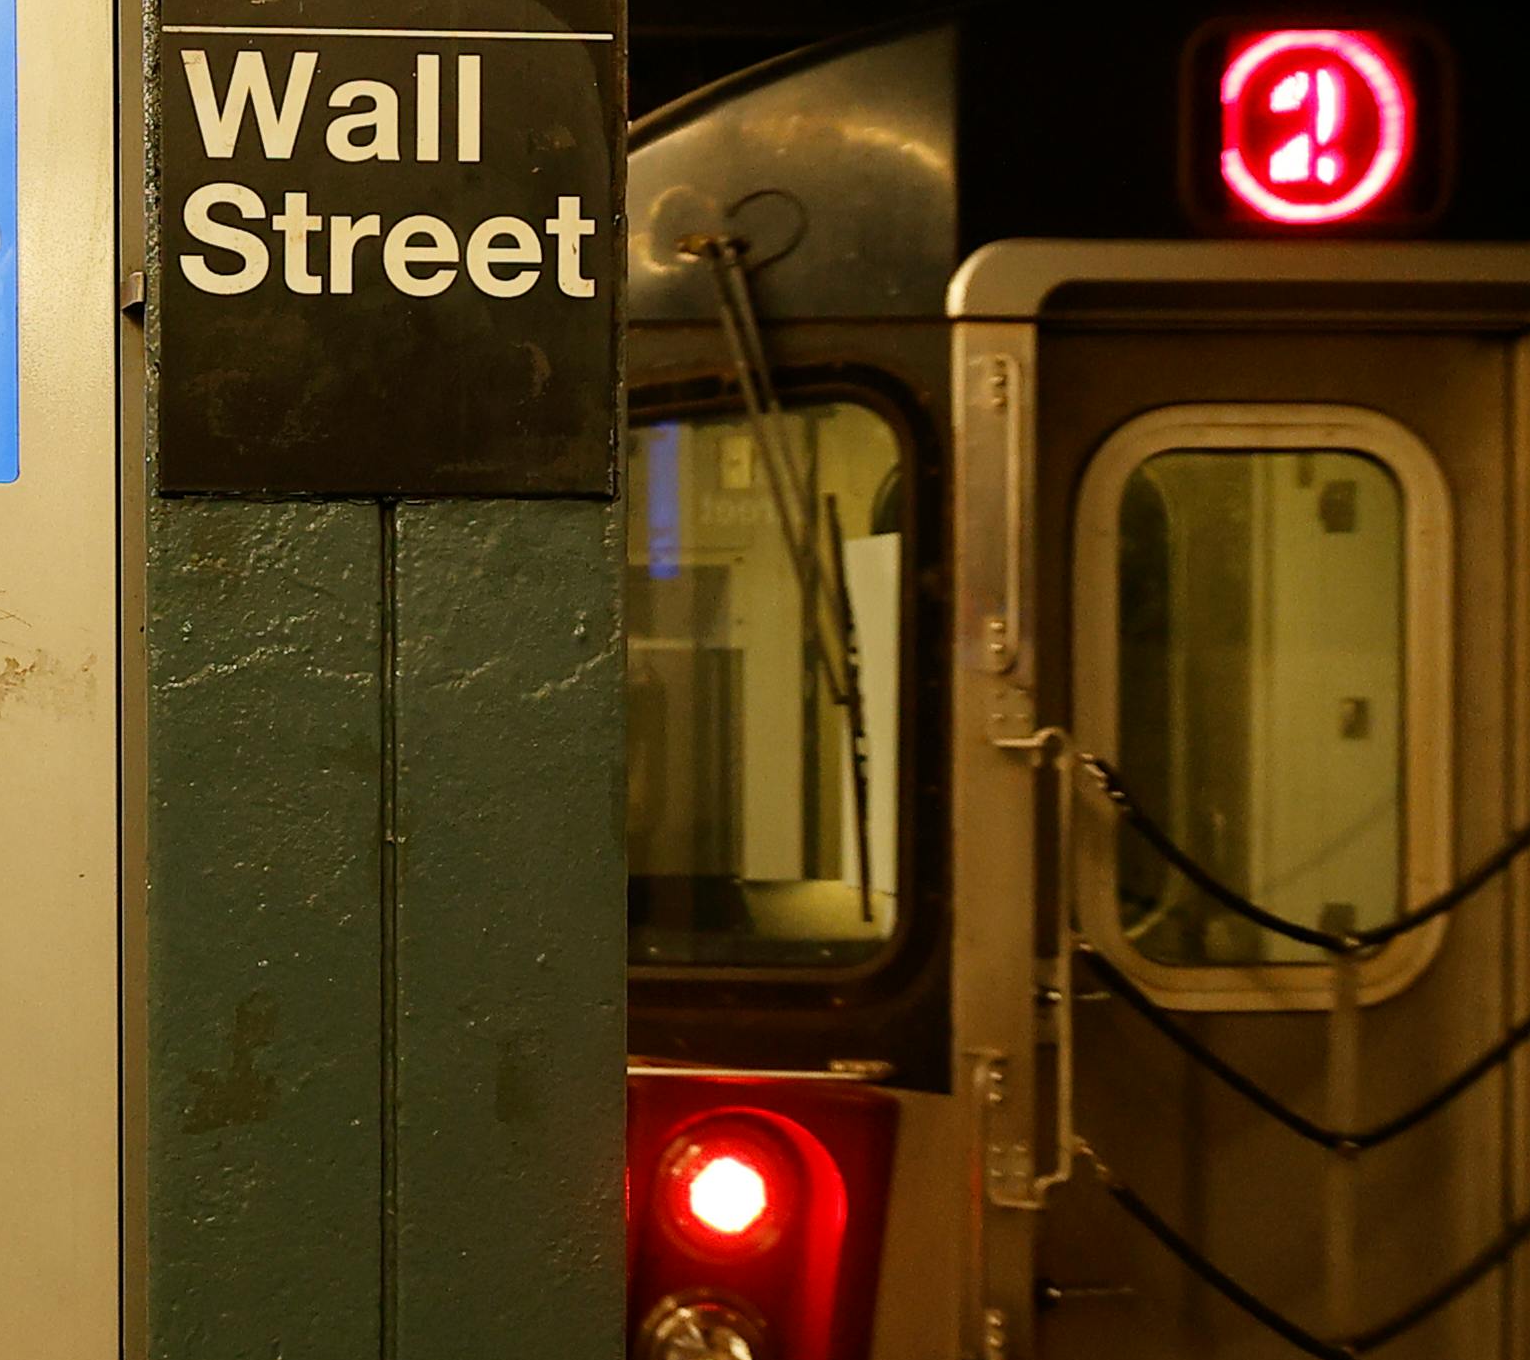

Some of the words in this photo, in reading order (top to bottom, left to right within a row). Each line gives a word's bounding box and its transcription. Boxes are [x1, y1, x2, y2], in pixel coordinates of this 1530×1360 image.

[179, 49, 482, 163] Wall
[1268, 67, 1345, 185] 2
[179, 182, 596, 299] Street
